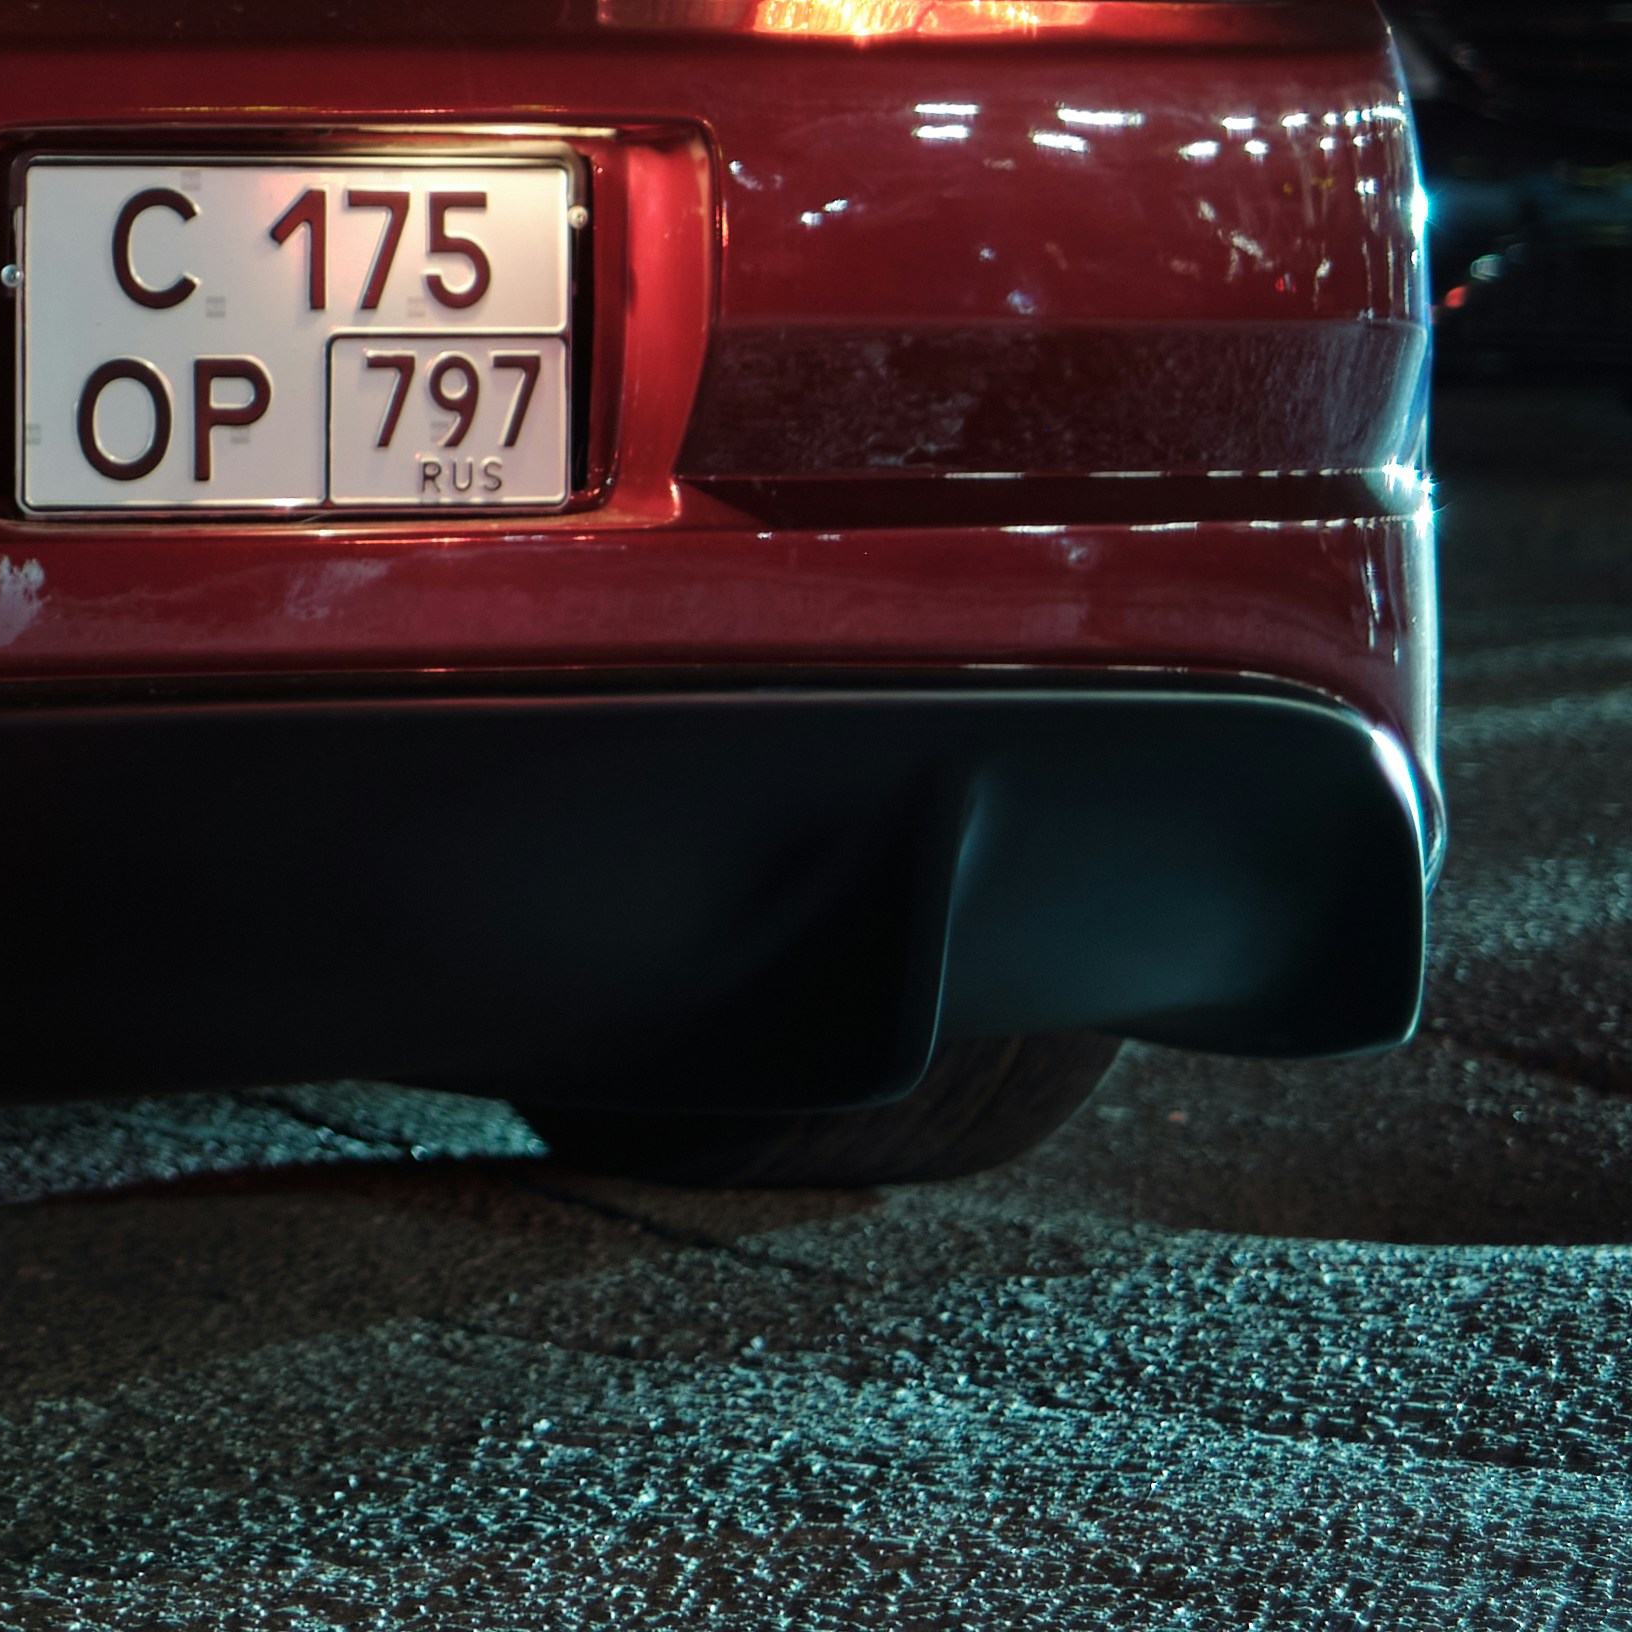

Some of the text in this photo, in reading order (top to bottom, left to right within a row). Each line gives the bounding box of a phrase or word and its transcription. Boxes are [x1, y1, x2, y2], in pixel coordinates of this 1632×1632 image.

[111, 186, 492, 311] C 175
[75, 350, 542, 482] OP 797
[420, 458, 504, 494] RUS
